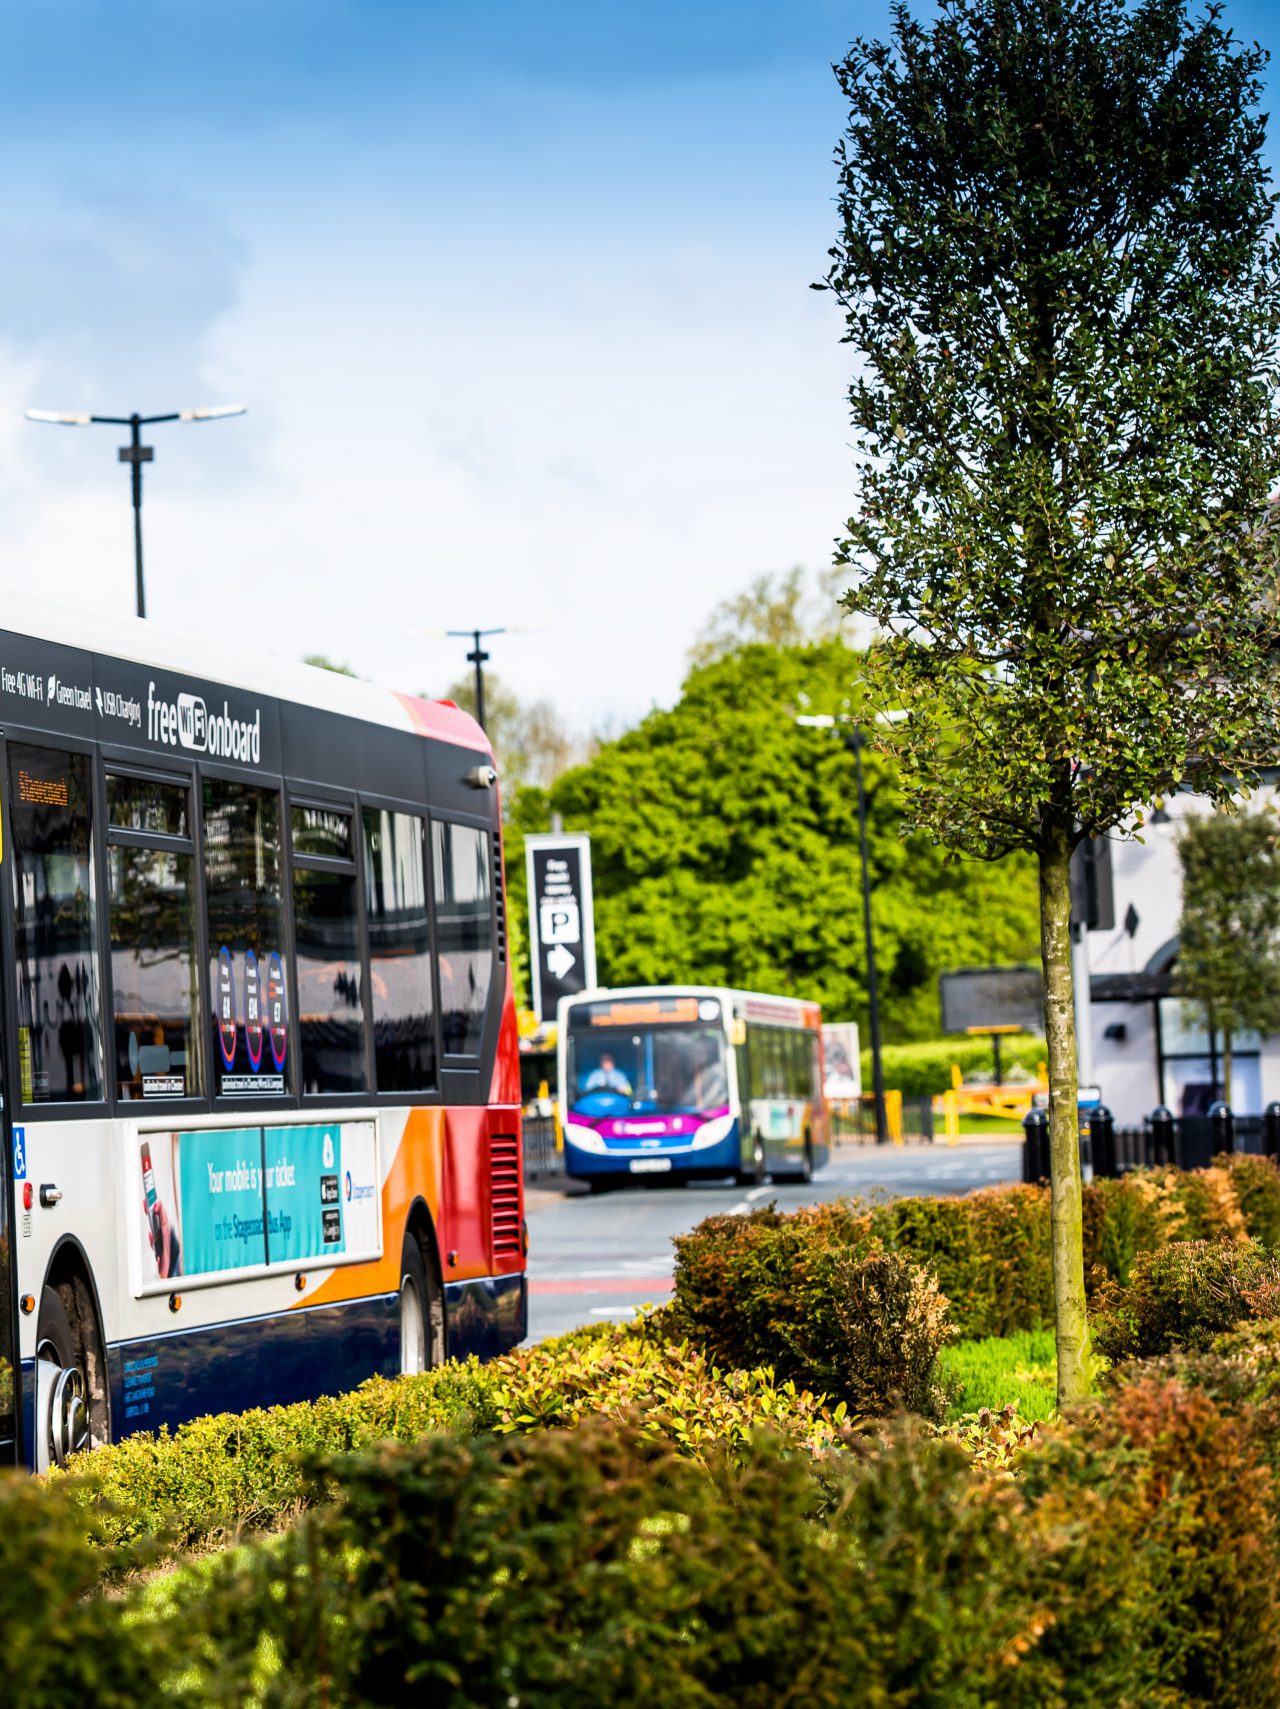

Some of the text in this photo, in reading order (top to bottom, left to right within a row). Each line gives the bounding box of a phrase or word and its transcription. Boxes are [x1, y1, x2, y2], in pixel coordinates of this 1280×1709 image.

[1, 667, 43, 701] Free 4G Wi-Fi
[56, 680, 93, 711] Green travel
[103, 691, 142, 728] USB Charging
[148, 680, 177, 746] free
[208, 700, 261, 764] onboard
[207, 1162, 224, 1194] Your
[225, 1158, 250, 1192] mobile
[250, 1161, 257, 1190] is
[257, 1166, 275, 1199] yur
[215, 1223, 223, 1241] on
[223, 1215, 233, 1241] the
[233, 1210, 266, 1245] Stagecoac
[279, 1209, 292, 1241] App
